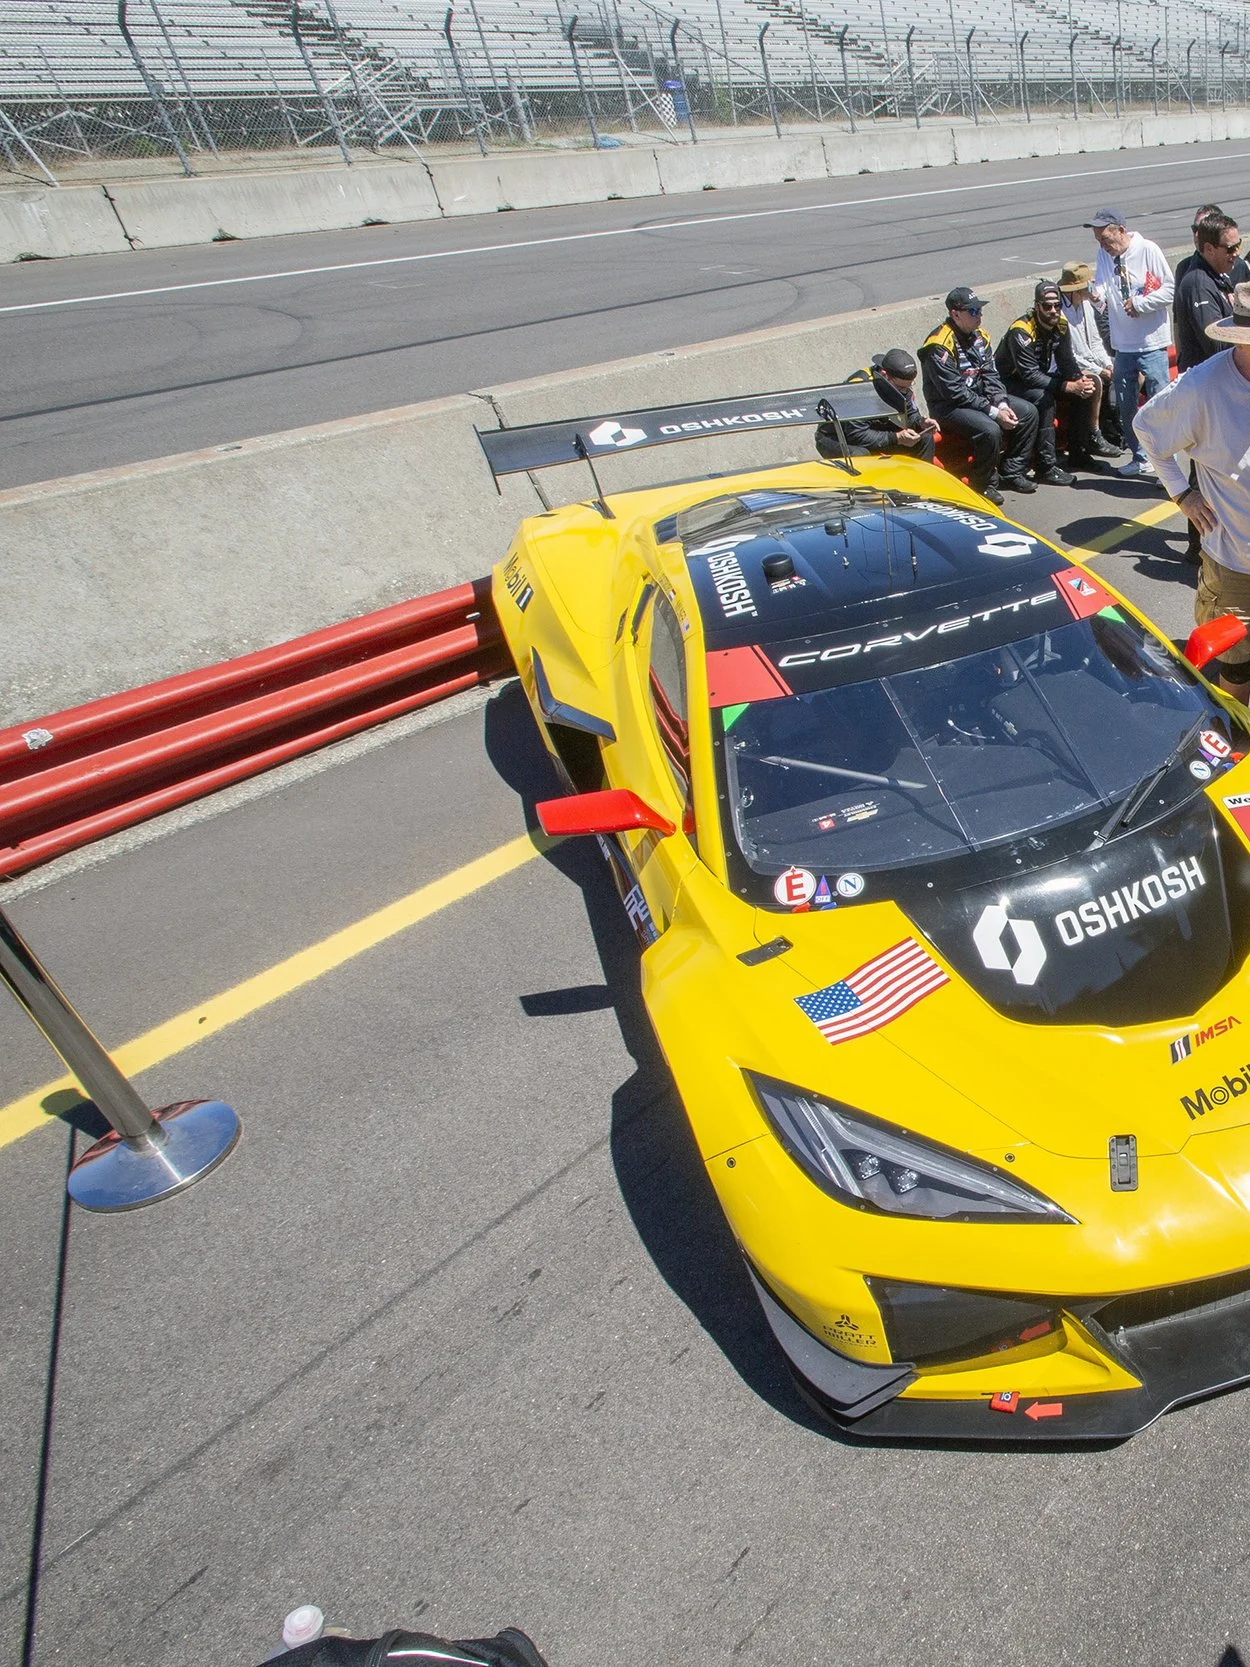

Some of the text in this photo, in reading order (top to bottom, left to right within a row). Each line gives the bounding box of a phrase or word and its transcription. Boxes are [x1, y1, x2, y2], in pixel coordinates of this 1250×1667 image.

[660, 408, 803, 435] OSHKOSH
[907, 501, 998, 531] OSHKOSH
[503, 551, 533, 610] Mobil 1
[706, 551, 754, 618] OSHKOSH
[777, 589, 1059, 668] CORVETTE
[1204, 733, 1228, 755] E
[785, 872, 806, 902] E
[843, 877, 857, 893] N
[1055, 856, 1206, 947] OSHKOSH
[1195, 1015, 1242, 1048] IMSA
[823, 1325, 875, 1340] PRATT
